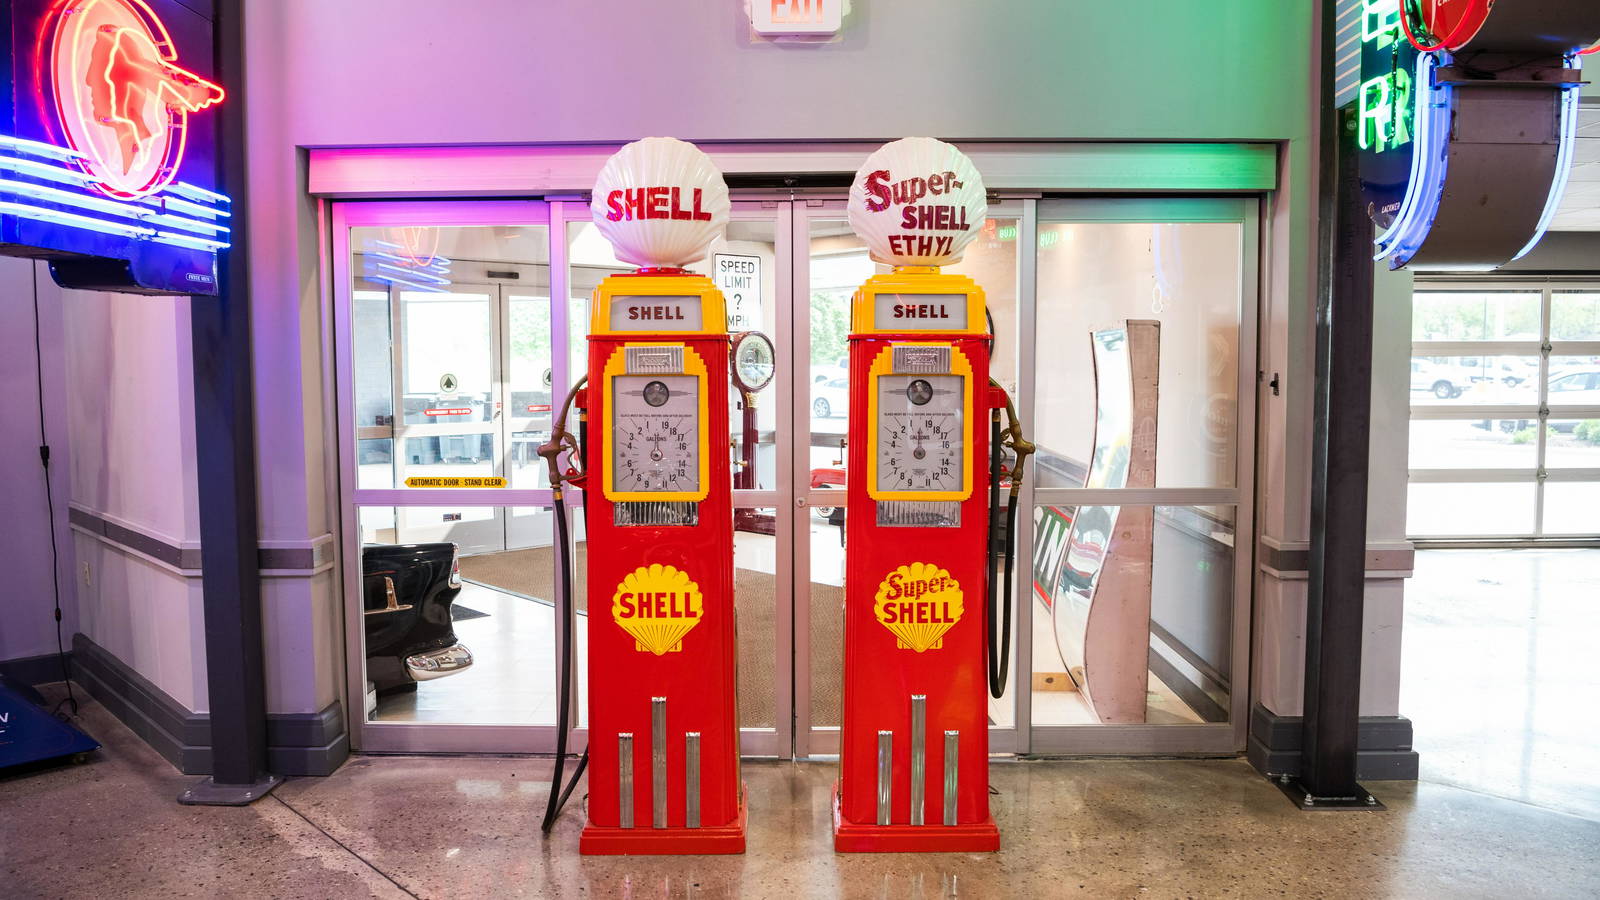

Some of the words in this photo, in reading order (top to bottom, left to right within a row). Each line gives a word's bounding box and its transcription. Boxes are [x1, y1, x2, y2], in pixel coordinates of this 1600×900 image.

[606, 186, 712, 222] SHELL
[901, 205, 970, 231] SHELL
[888, 235, 953, 257] ETHYL
[720, 260, 755, 274] SPEED
[724, 276, 751, 289] LIMIT
[628, 306, 684, 320] SHELL
[893, 304, 949, 318] SHELL
[727, 315, 749, 327] MPH
[662, 421, 669, 429] 19
[925, 420, 933, 428] 19
[669, 427, 677, 435] 18
[933, 426, 940, 434] 18
[940, 432, 948, 440] 17
[679, 442, 687, 450] 16
[679, 460, 686, 468] 14
[942, 458, 949, 466] 14
[678, 469, 685, 477] 13
[941, 467, 948, 475] 13
[669, 474, 677, 482] 12
[619, 592, 697, 618] SHELL
[883, 602, 954, 624] SHELL
